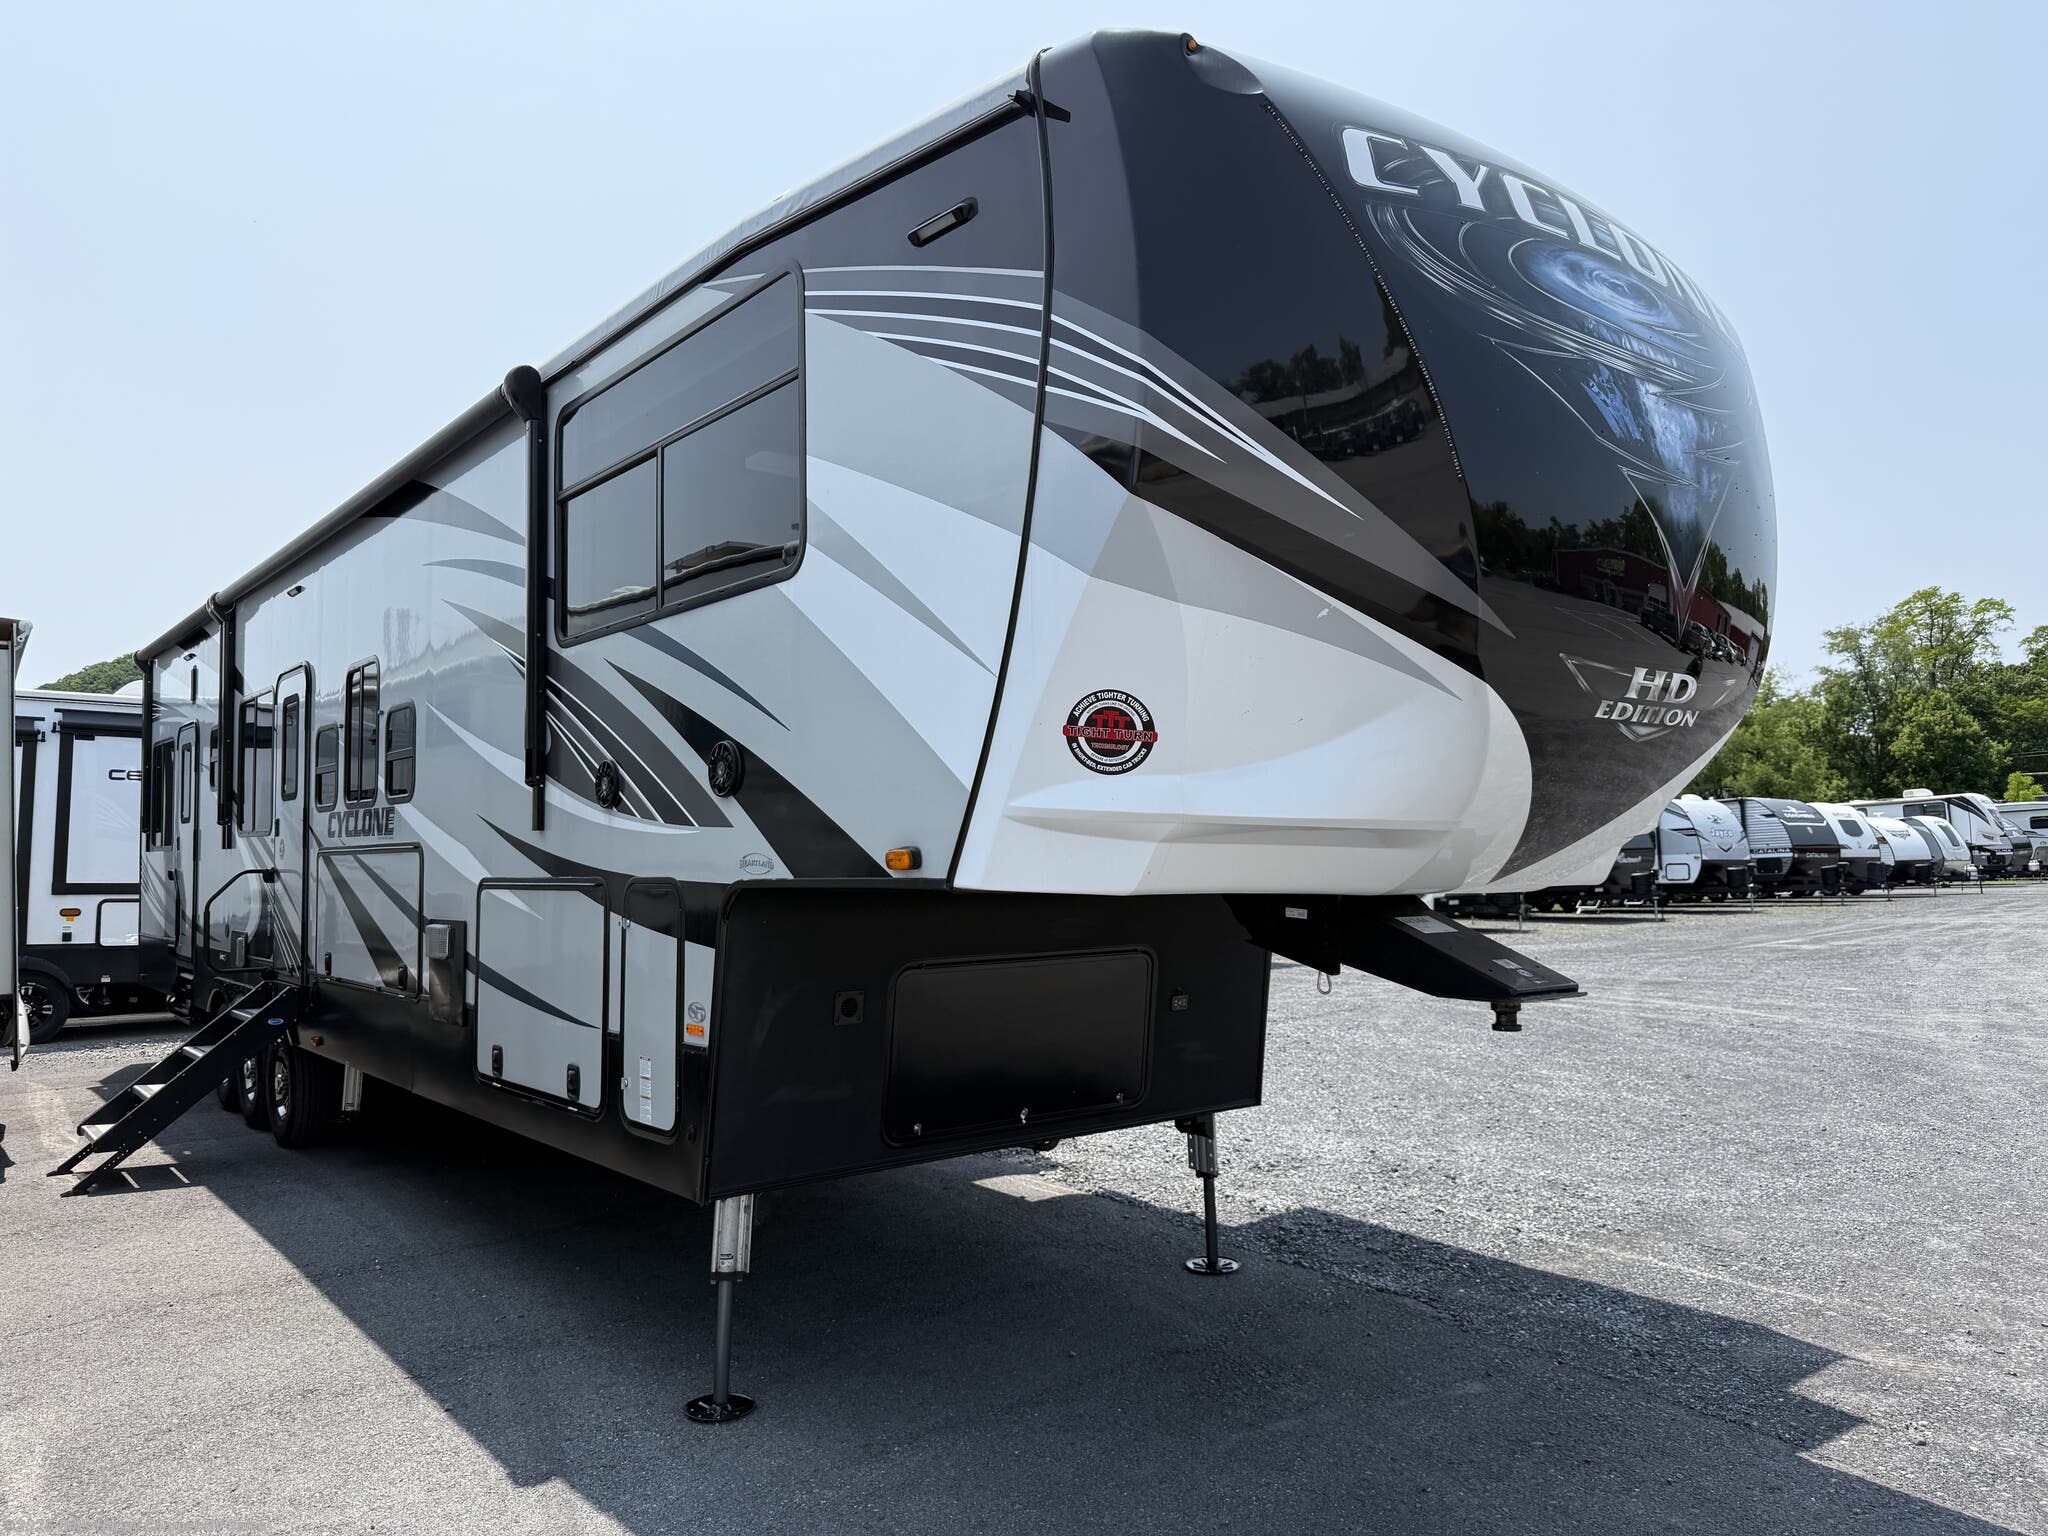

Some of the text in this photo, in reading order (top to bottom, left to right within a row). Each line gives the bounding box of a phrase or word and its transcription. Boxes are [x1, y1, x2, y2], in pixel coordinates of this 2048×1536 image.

[1624, 666, 1698, 704] HD
[1073, 691, 1150, 722] ACHIEVE TIGHTER TURNING
[1594, 699, 1700, 728] EDITION
[1068, 725, 1154, 742] TIGHT TURN
[1096, 764, 1123, 772] EXTENDED
[328, 806, 395, 838] CYCLONE
[1710, 828, 1735, 839] Jayco
